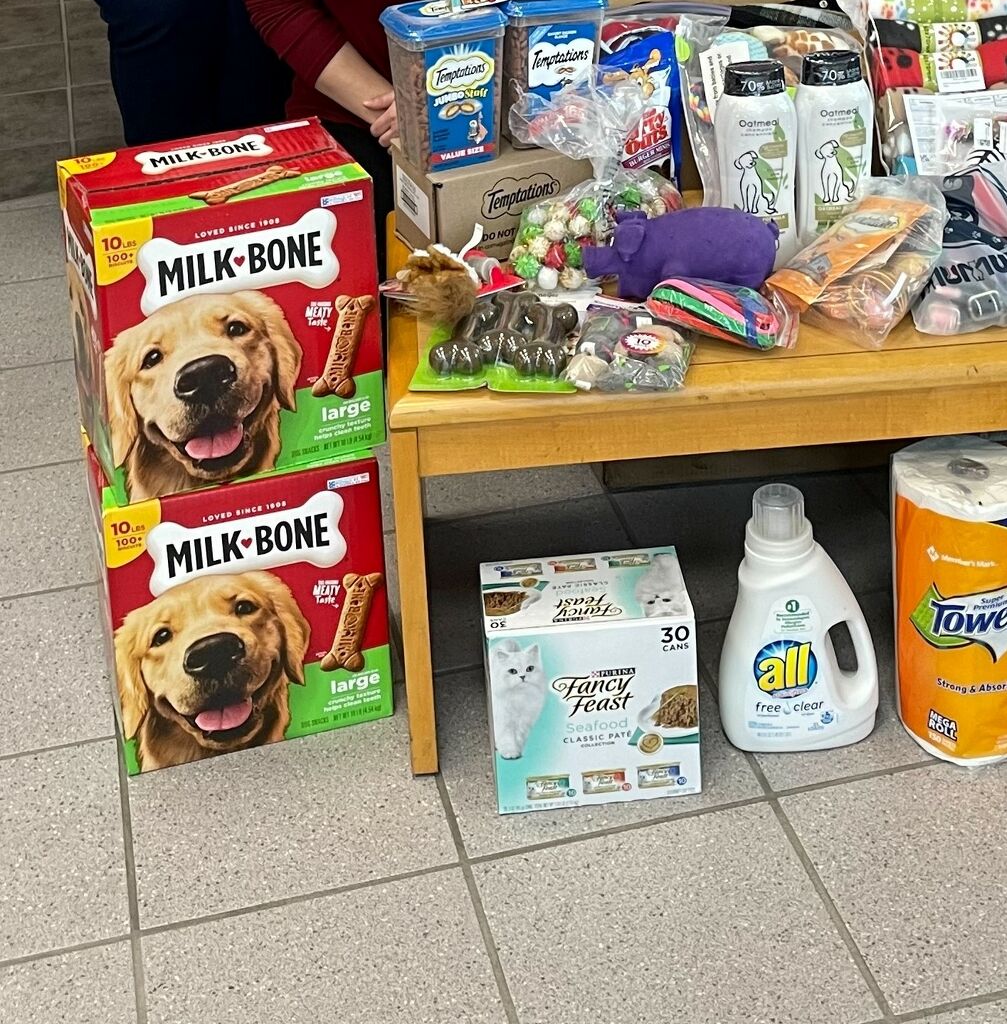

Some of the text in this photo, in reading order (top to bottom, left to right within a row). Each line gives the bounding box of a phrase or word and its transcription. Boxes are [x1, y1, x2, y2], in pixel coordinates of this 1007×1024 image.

[532, 48, 589, 70] Temptations
[436, 61, 486, 87] Temptations
[821, 69, 845, 81] 70%
[740, 80, 765, 92] 70%
[433, 88, 489, 107] JUMBO Stuff
[820, 106, 859, 118] Oatmeal
[739, 118, 779, 128] Oatmeal
[149, 151, 200, 168] MILK
[207, 141, 260, 157] BONE
[441, 146, 485, 161] VALUE SIZE
[488, 180, 555, 213] Temptations
[194, 217, 281, 239] LOVED SINCE 1908
[482, 227, 516, 242] DO NOT
[102, 237, 122, 252] 10
[107, 253, 134, 264] 100+
[158, 231, 323, 297] MILK BONE
[305, 306, 334, 318] MEATY
[307, 317, 328, 327] Taste
[322, 399, 371, 422] large
[314, 431, 333, 441] helps
[318, 423, 346, 434] crunchy
[202, 511, 233, 523] LOVED
[235, 505, 262, 517] SINCE
[111, 521, 131, 536] 10
[116, 537, 143, 547] 100+
[166, 512, 330, 578] MILK BONE
[313, 584, 341, 596] MEATY
[315, 596, 336, 605] Taste
[554, 593, 607, 609] Feast
[981, 595, 1004, 604] Super
[552, 604, 622, 621] Fancy
[490, 621, 507, 629] 30
[661, 625, 690, 644] 30
[662, 642, 689, 652] CANS
[758, 642, 812, 692] all
[331, 673, 381, 695] large
[552, 675, 635, 699] Fancy
[937, 678, 967, 694] Strong
[328, 696, 355, 706] crunchy
[566, 692, 634, 717] Feast
[756, 701, 824, 713] free clear
[566, 717, 628, 734] Seafood
[930, 710, 956, 730] MEGA
[928, 718, 957, 740] ROLL
[563, 730, 632, 744] CLASSIC PATÉ
